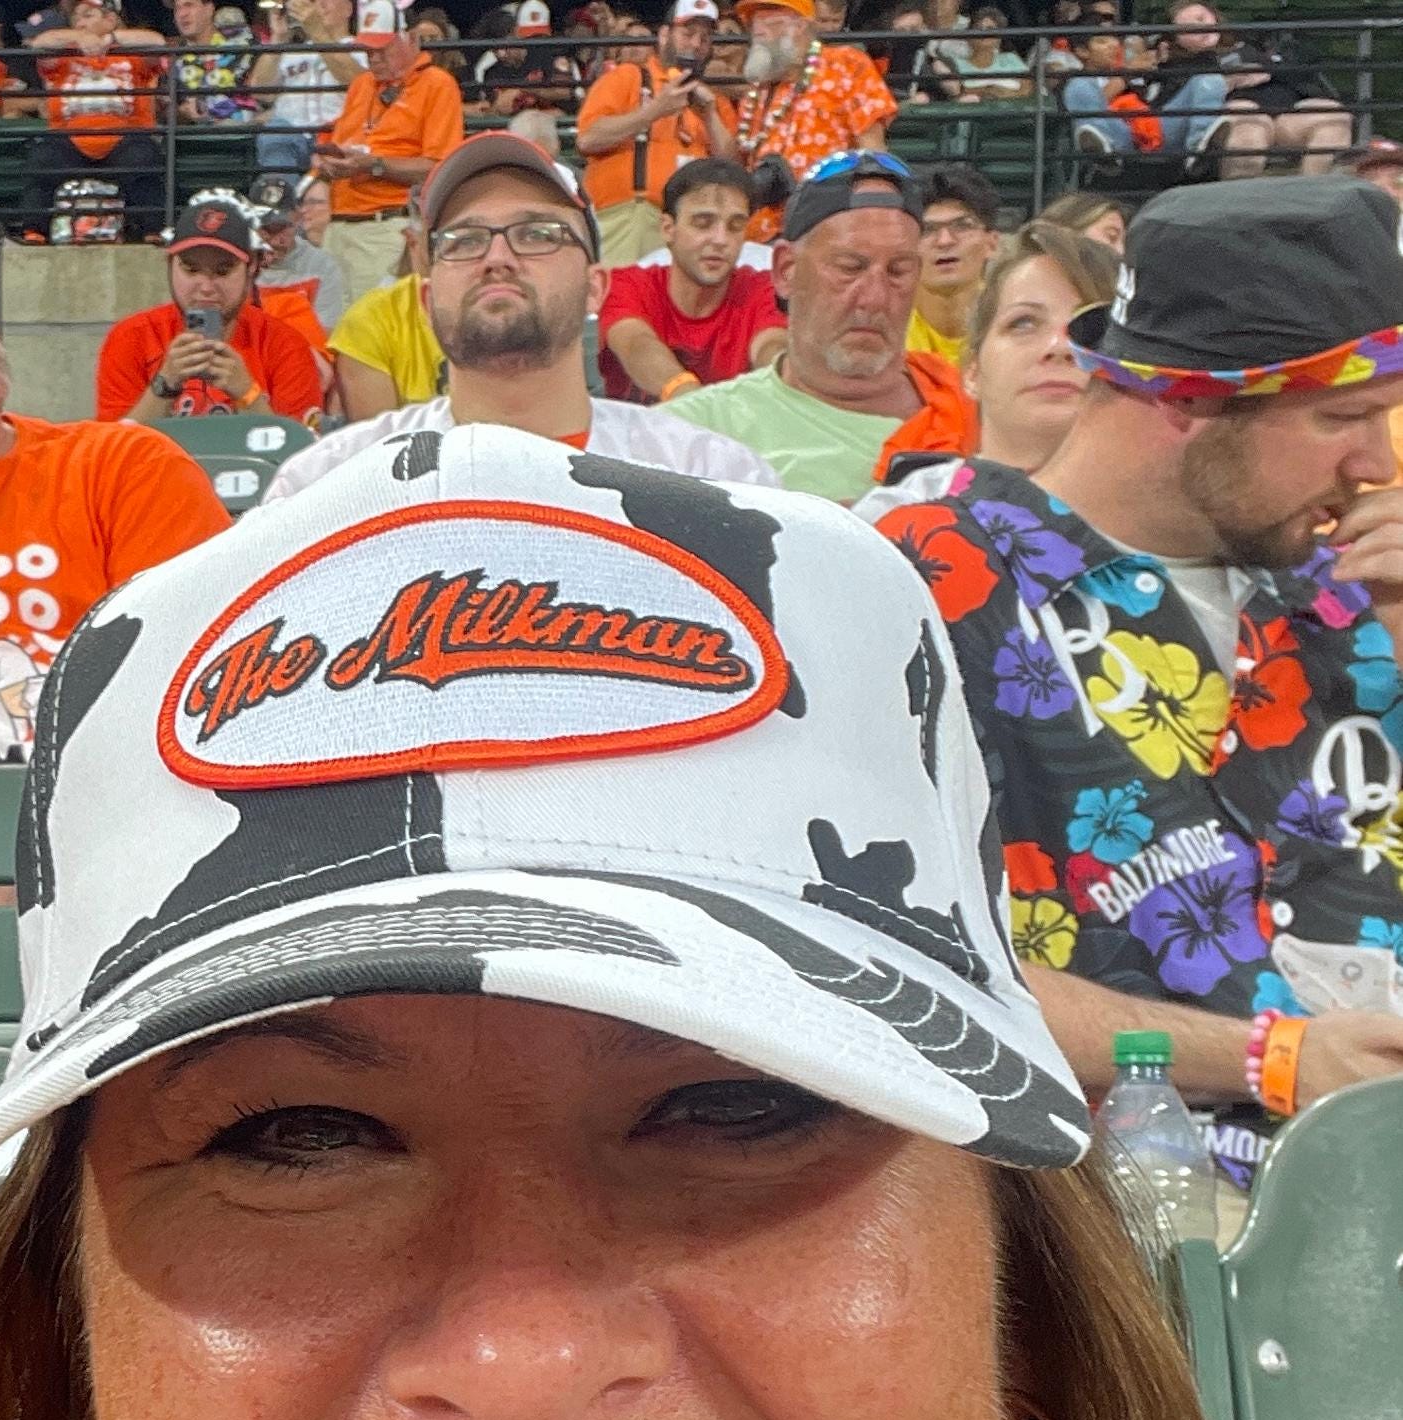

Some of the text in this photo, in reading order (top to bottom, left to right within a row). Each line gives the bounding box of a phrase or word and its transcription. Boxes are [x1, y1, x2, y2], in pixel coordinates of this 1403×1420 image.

[185, 567, 756, 745] The Milkman
[1087, 818, 1238, 924] BALTIMORE
